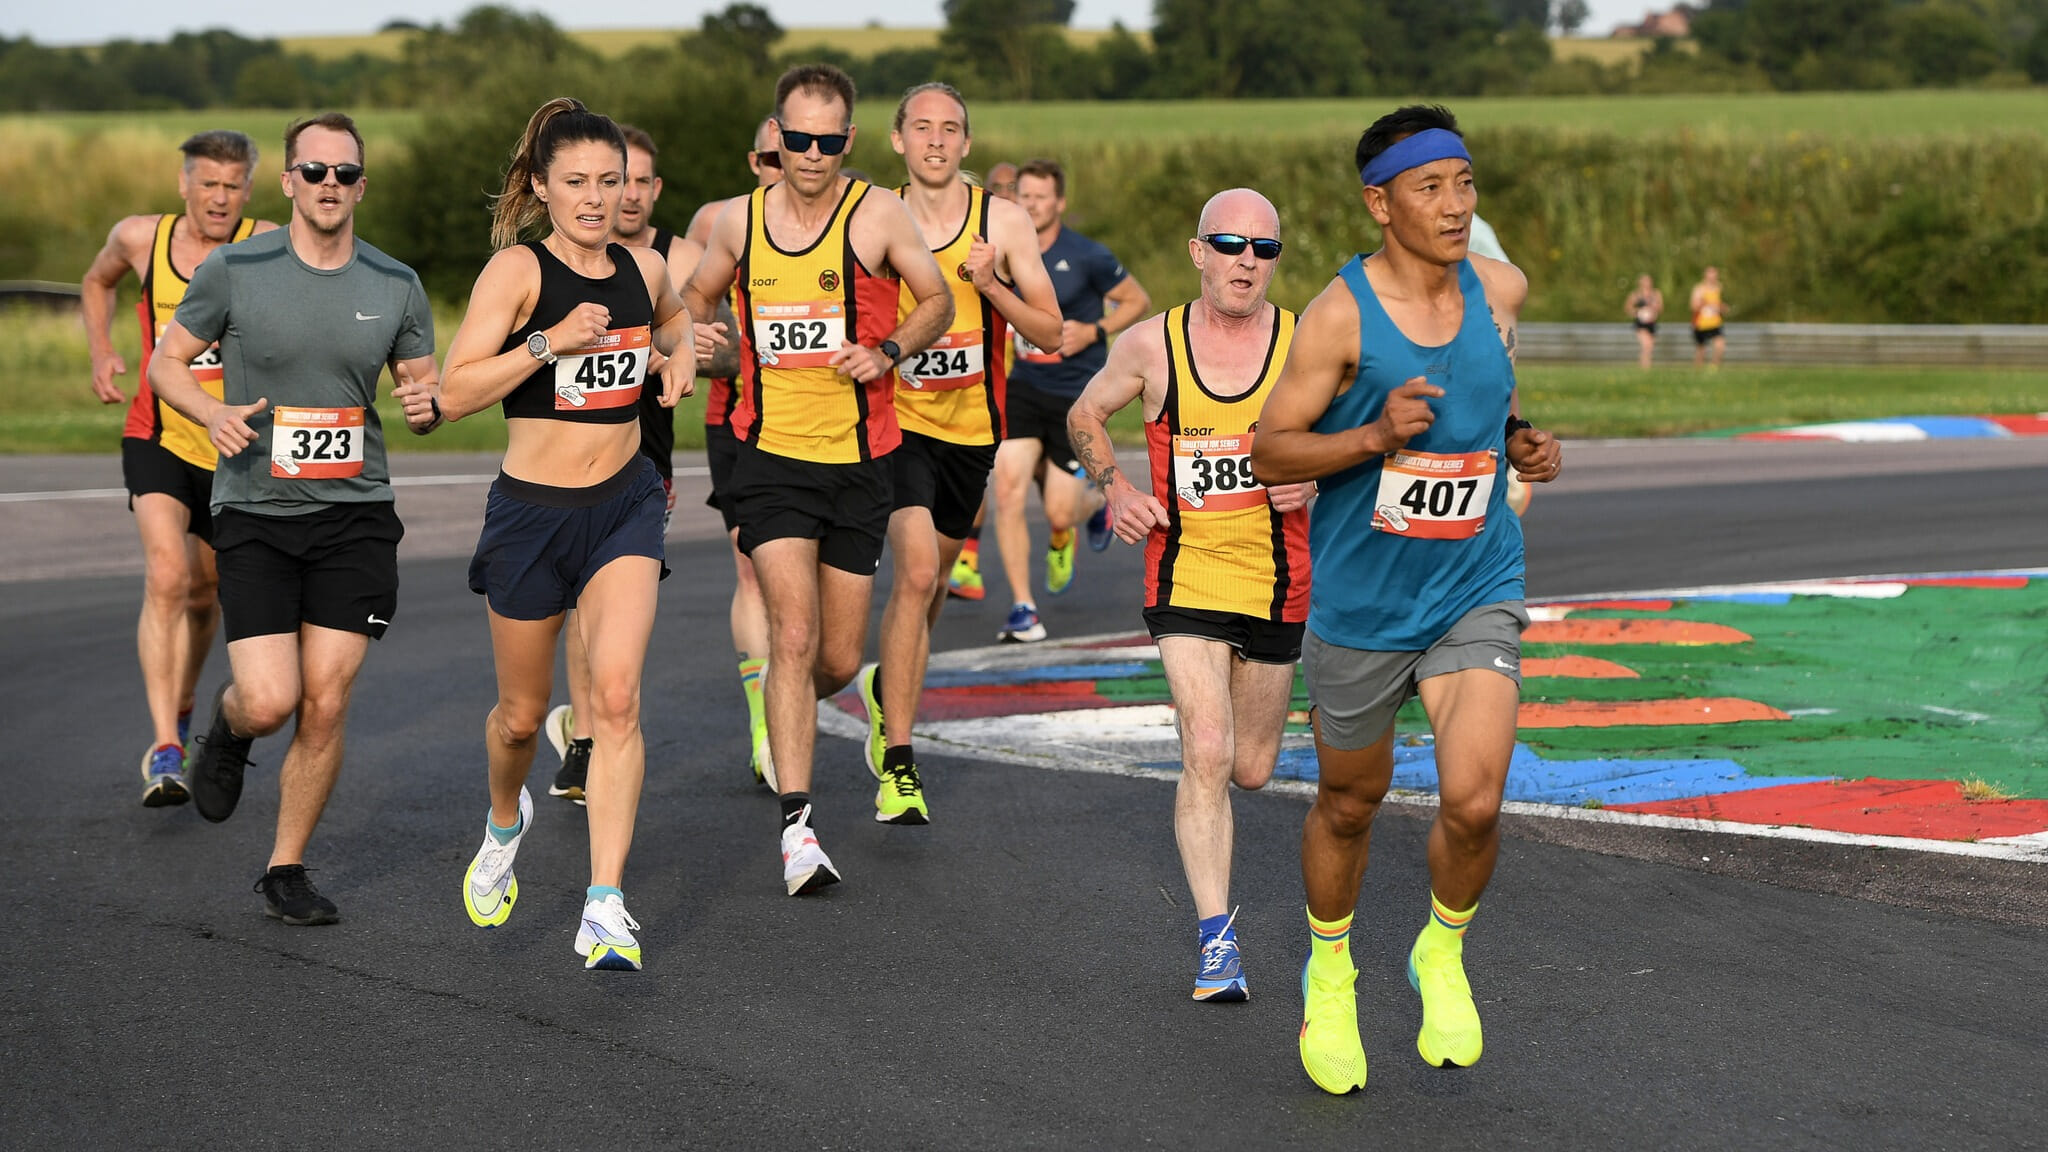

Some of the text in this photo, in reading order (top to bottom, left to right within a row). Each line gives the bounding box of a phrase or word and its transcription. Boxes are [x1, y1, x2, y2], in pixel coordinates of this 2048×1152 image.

[752, 278, 778, 286] soar
[769, 321, 828, 351] 362
[575, 351, 636, 389] 452
[912, 350, 968, 376] 234
[291, 429, 351, 460] 323
[1184, 427, 1214, 436] soar
[1192, 457, 1259, 491] 389
[1400, 479, 1478, 517] 407
